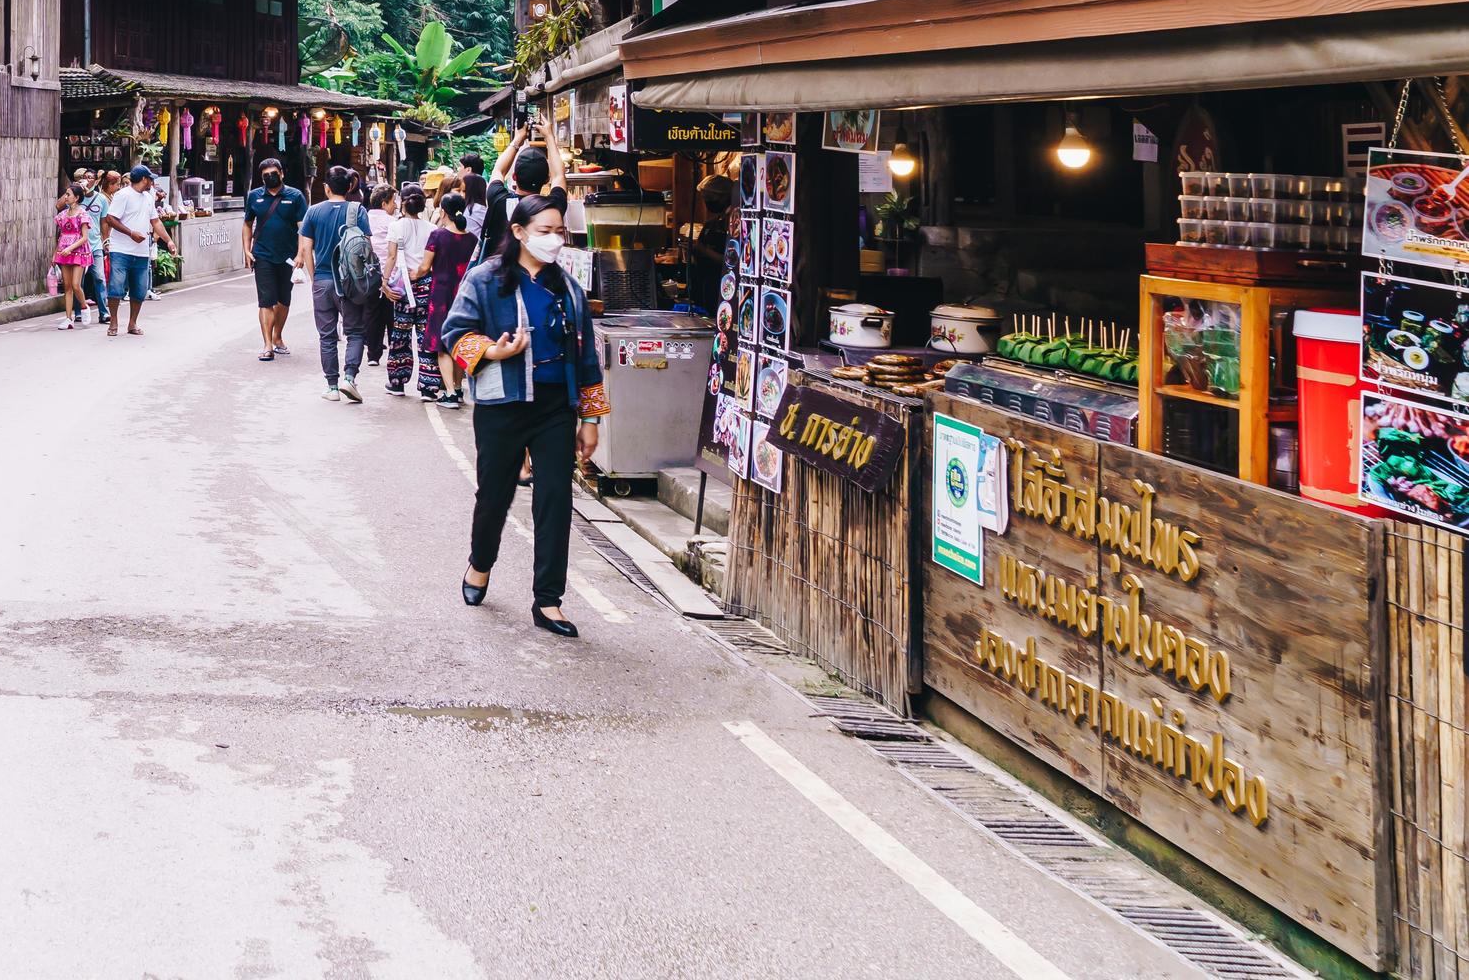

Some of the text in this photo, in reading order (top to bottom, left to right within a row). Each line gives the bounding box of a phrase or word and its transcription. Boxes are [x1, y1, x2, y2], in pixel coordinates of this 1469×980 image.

[799, 413, 877, 470] การย่าง
[999, 553, 1231, 703] แหนมย่างใบตอง
